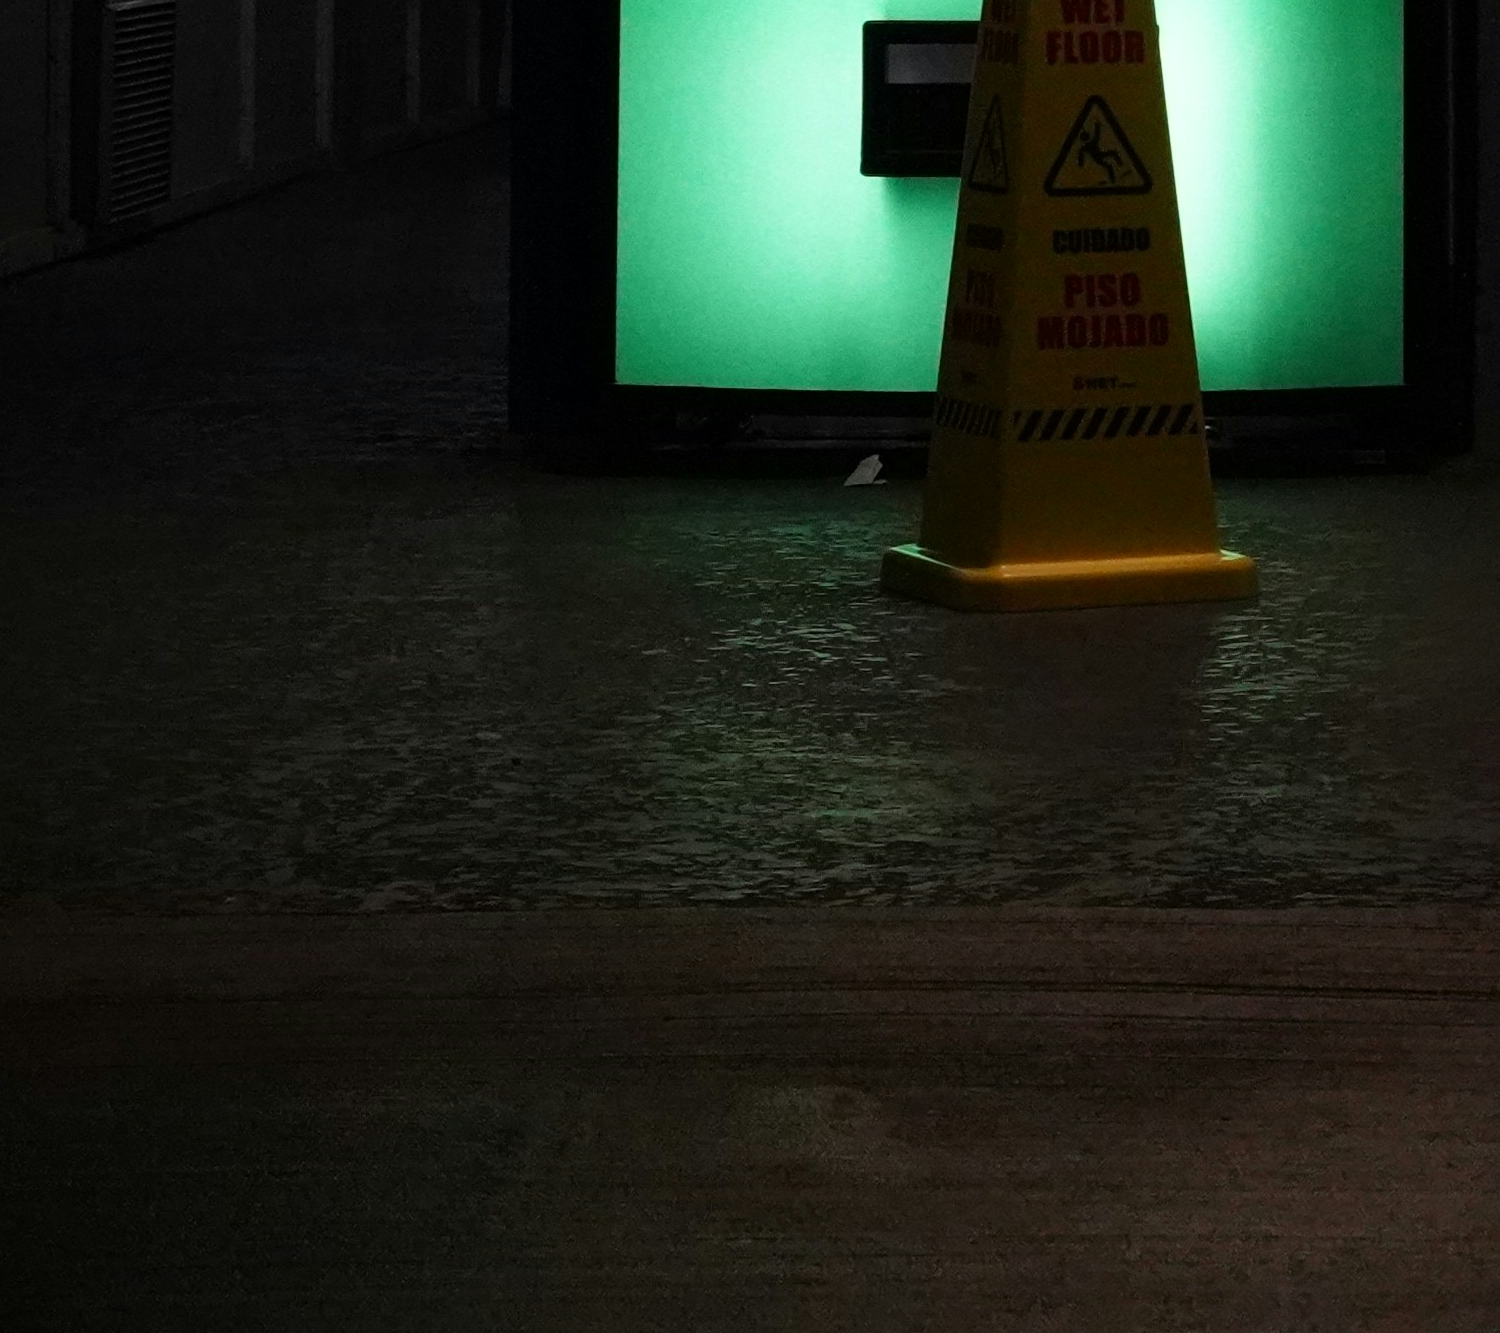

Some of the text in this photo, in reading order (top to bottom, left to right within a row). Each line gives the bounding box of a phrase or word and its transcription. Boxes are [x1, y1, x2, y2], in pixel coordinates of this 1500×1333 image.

[1045, 30, 1145, 65] FLOOR
[1052, 226, 1150, 253] CUIDADO
[1064, 273, 1141, 308] PISO
[1037, 313, 1169, 349] MOJADO
